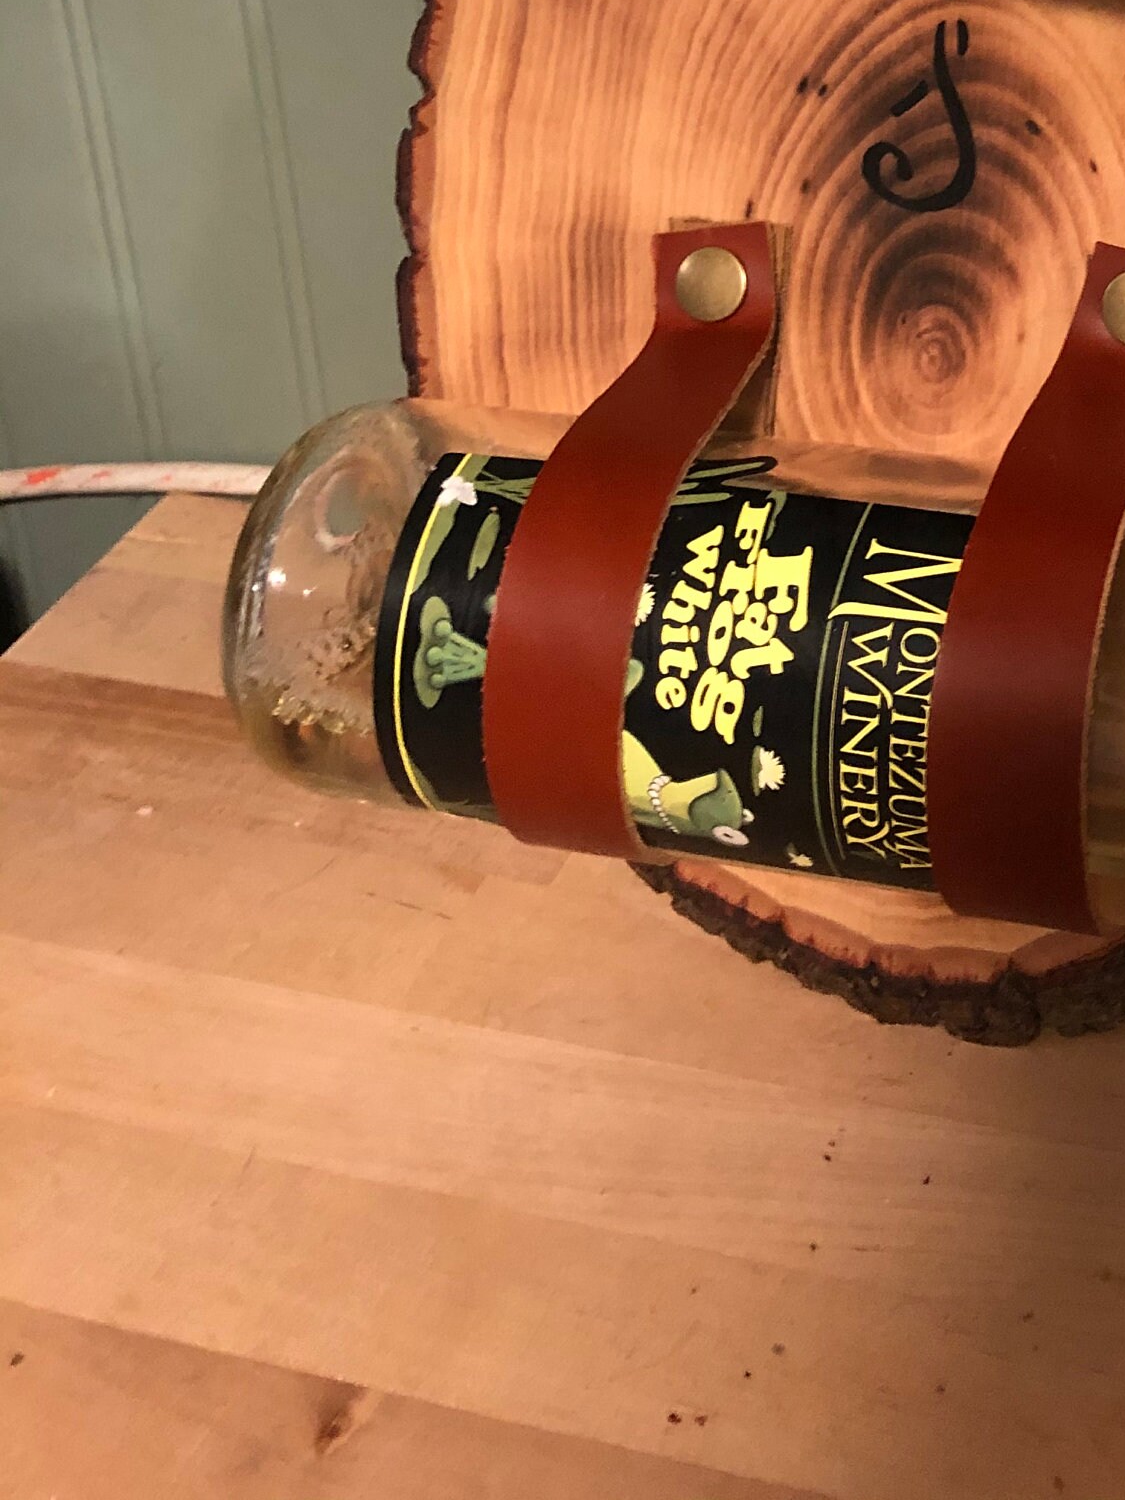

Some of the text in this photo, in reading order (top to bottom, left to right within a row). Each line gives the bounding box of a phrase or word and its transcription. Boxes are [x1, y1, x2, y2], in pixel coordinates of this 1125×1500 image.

[690, 500, 773, 745] Frog
[730, 545, 814, 680] Fat
[828, 537, 964, 869] MONTEZUMA
[840, 622, 894, 858] WINERY
